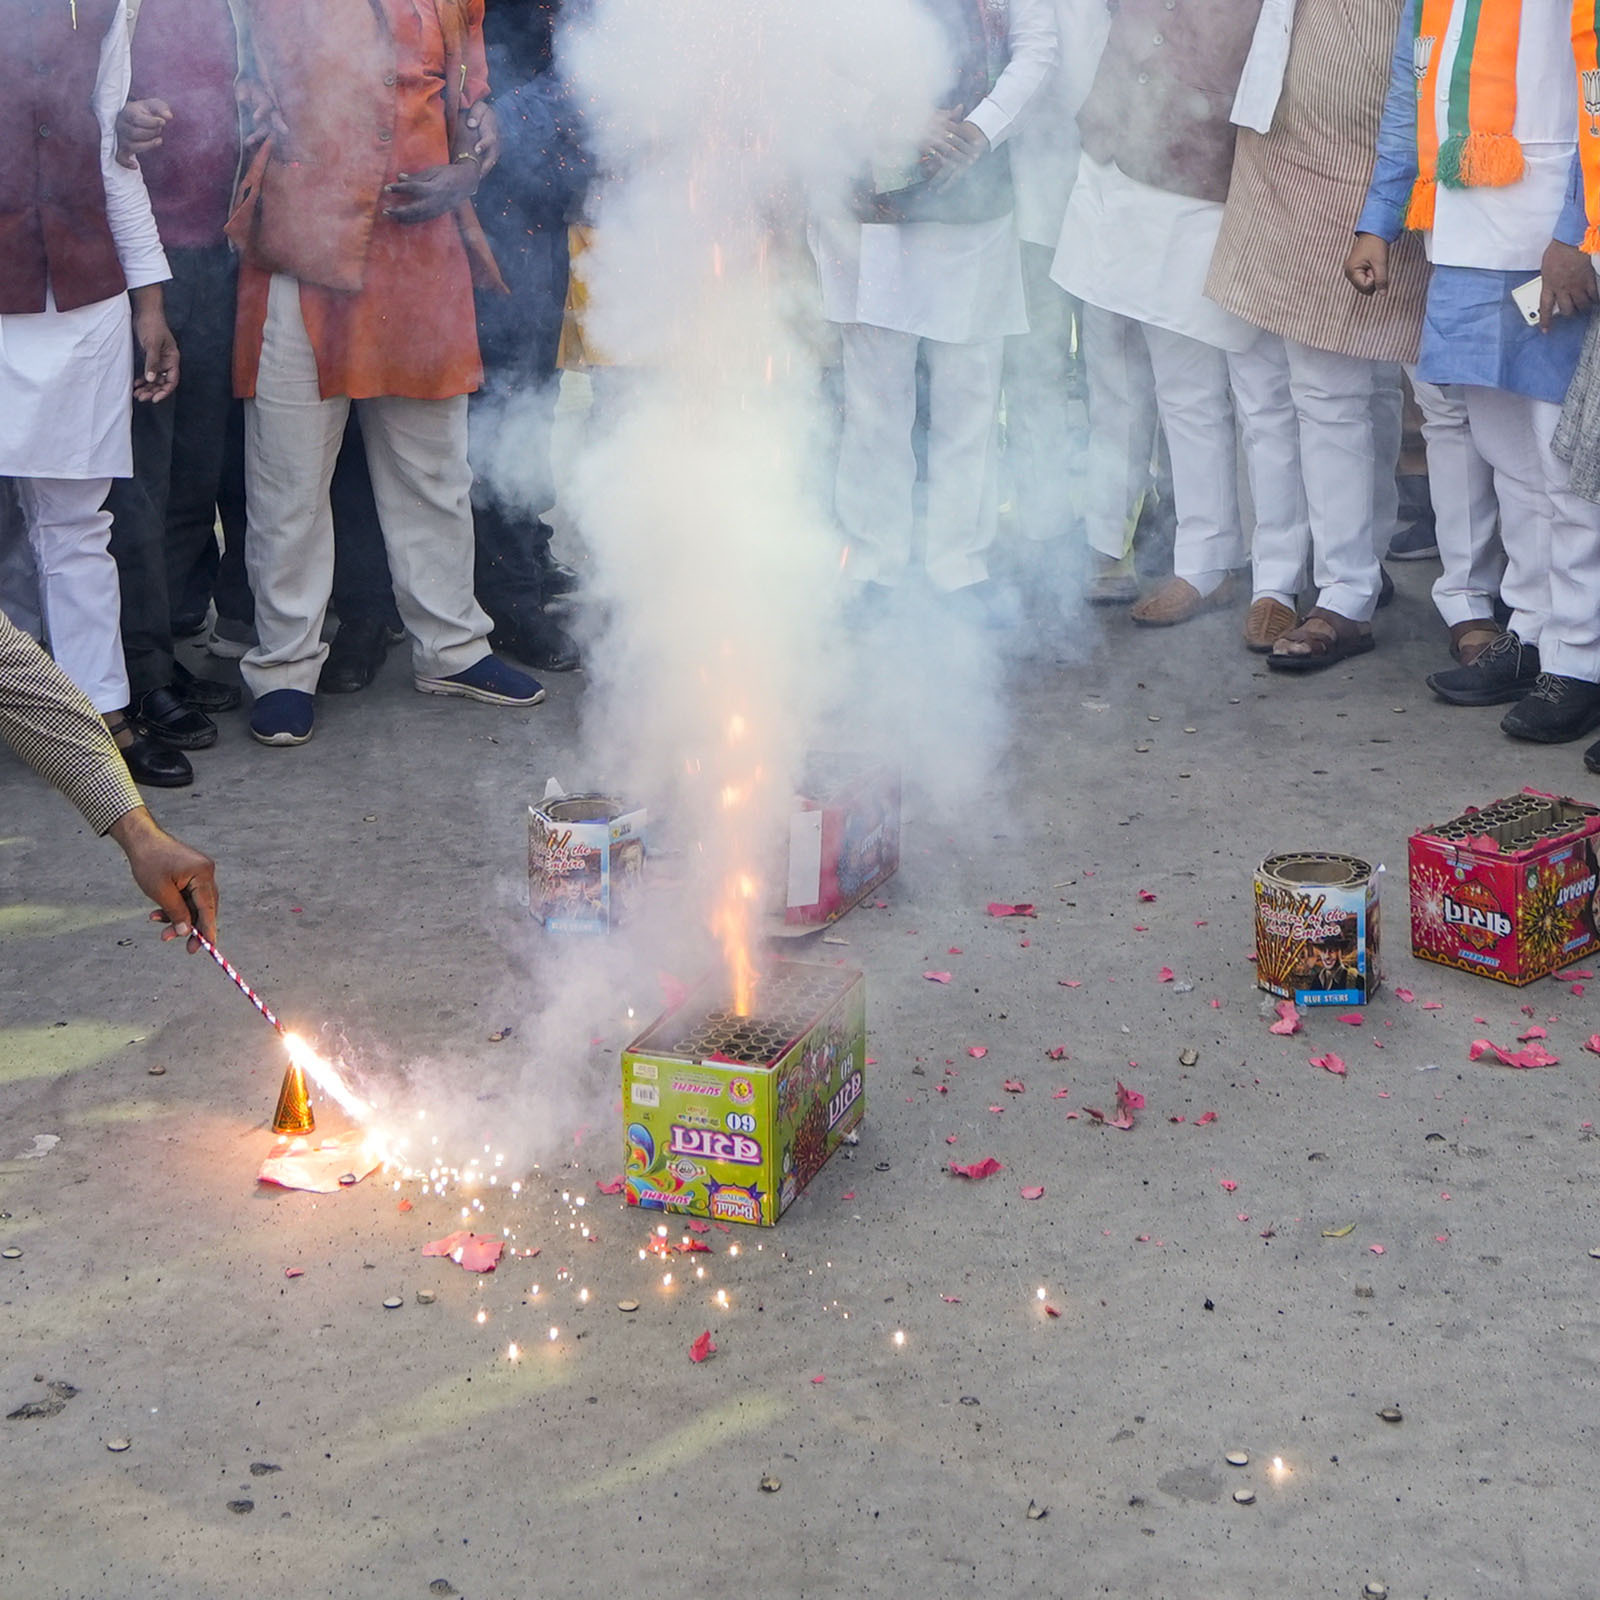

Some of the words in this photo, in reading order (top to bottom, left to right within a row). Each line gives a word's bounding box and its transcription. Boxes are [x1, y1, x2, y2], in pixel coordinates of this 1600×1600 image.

[1556, 874, 1596, 907] BARAAT
[1325, 906, 1347, 922] the
[1292, 924, 1341, 942] Empire
[840, 1053, 853, 1080] 60
[672, 1082, 721, 1096] SUPREME
[726, 1113, 756, 1132] 60
[640, 1190, 692, 1205] SUPREME
[716, 1201, 755, 1220] Bridal
